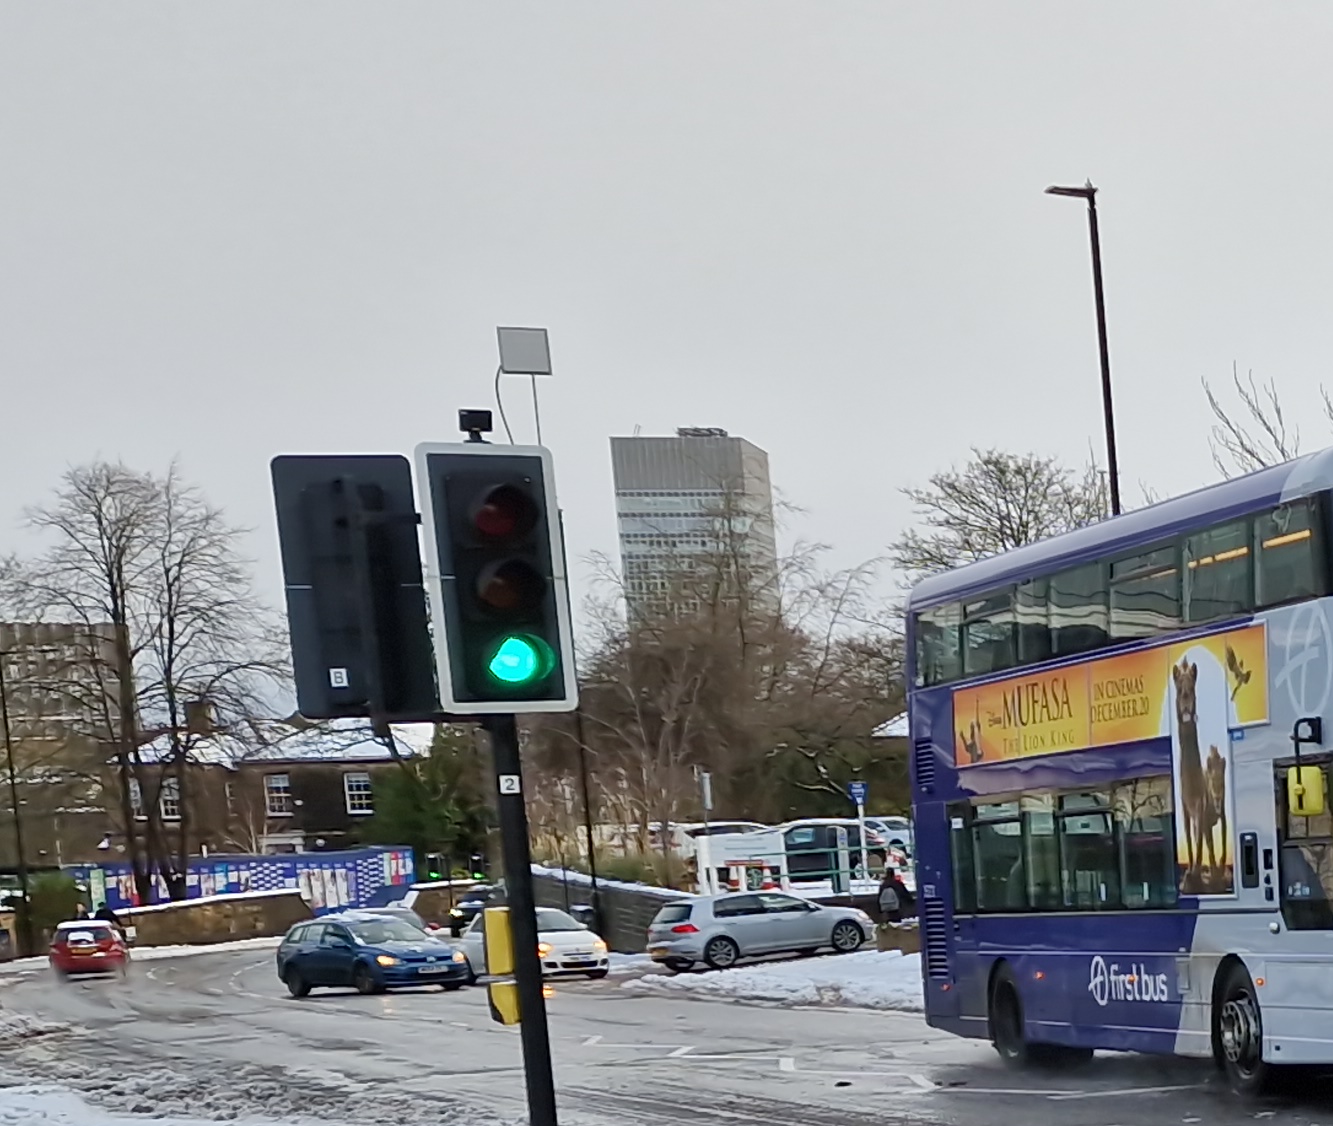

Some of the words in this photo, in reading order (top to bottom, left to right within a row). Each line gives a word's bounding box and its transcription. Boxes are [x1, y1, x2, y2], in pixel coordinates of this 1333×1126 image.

[1094, 681, 1104, 701] IN
[1106, 674, 1144, 699] CINEMAS
[1002, 677, 1073, 730] MUFASA
[1090, 698, 1138, 724] DECEMBER
[1139, 696, 1150, 716] 20
[1003, 737, 1021, 755] THE
[1023, 733, 1045, 752] LION
[1050, 729, 1075, 746] KING
[505, 778, 514, 791] 2
